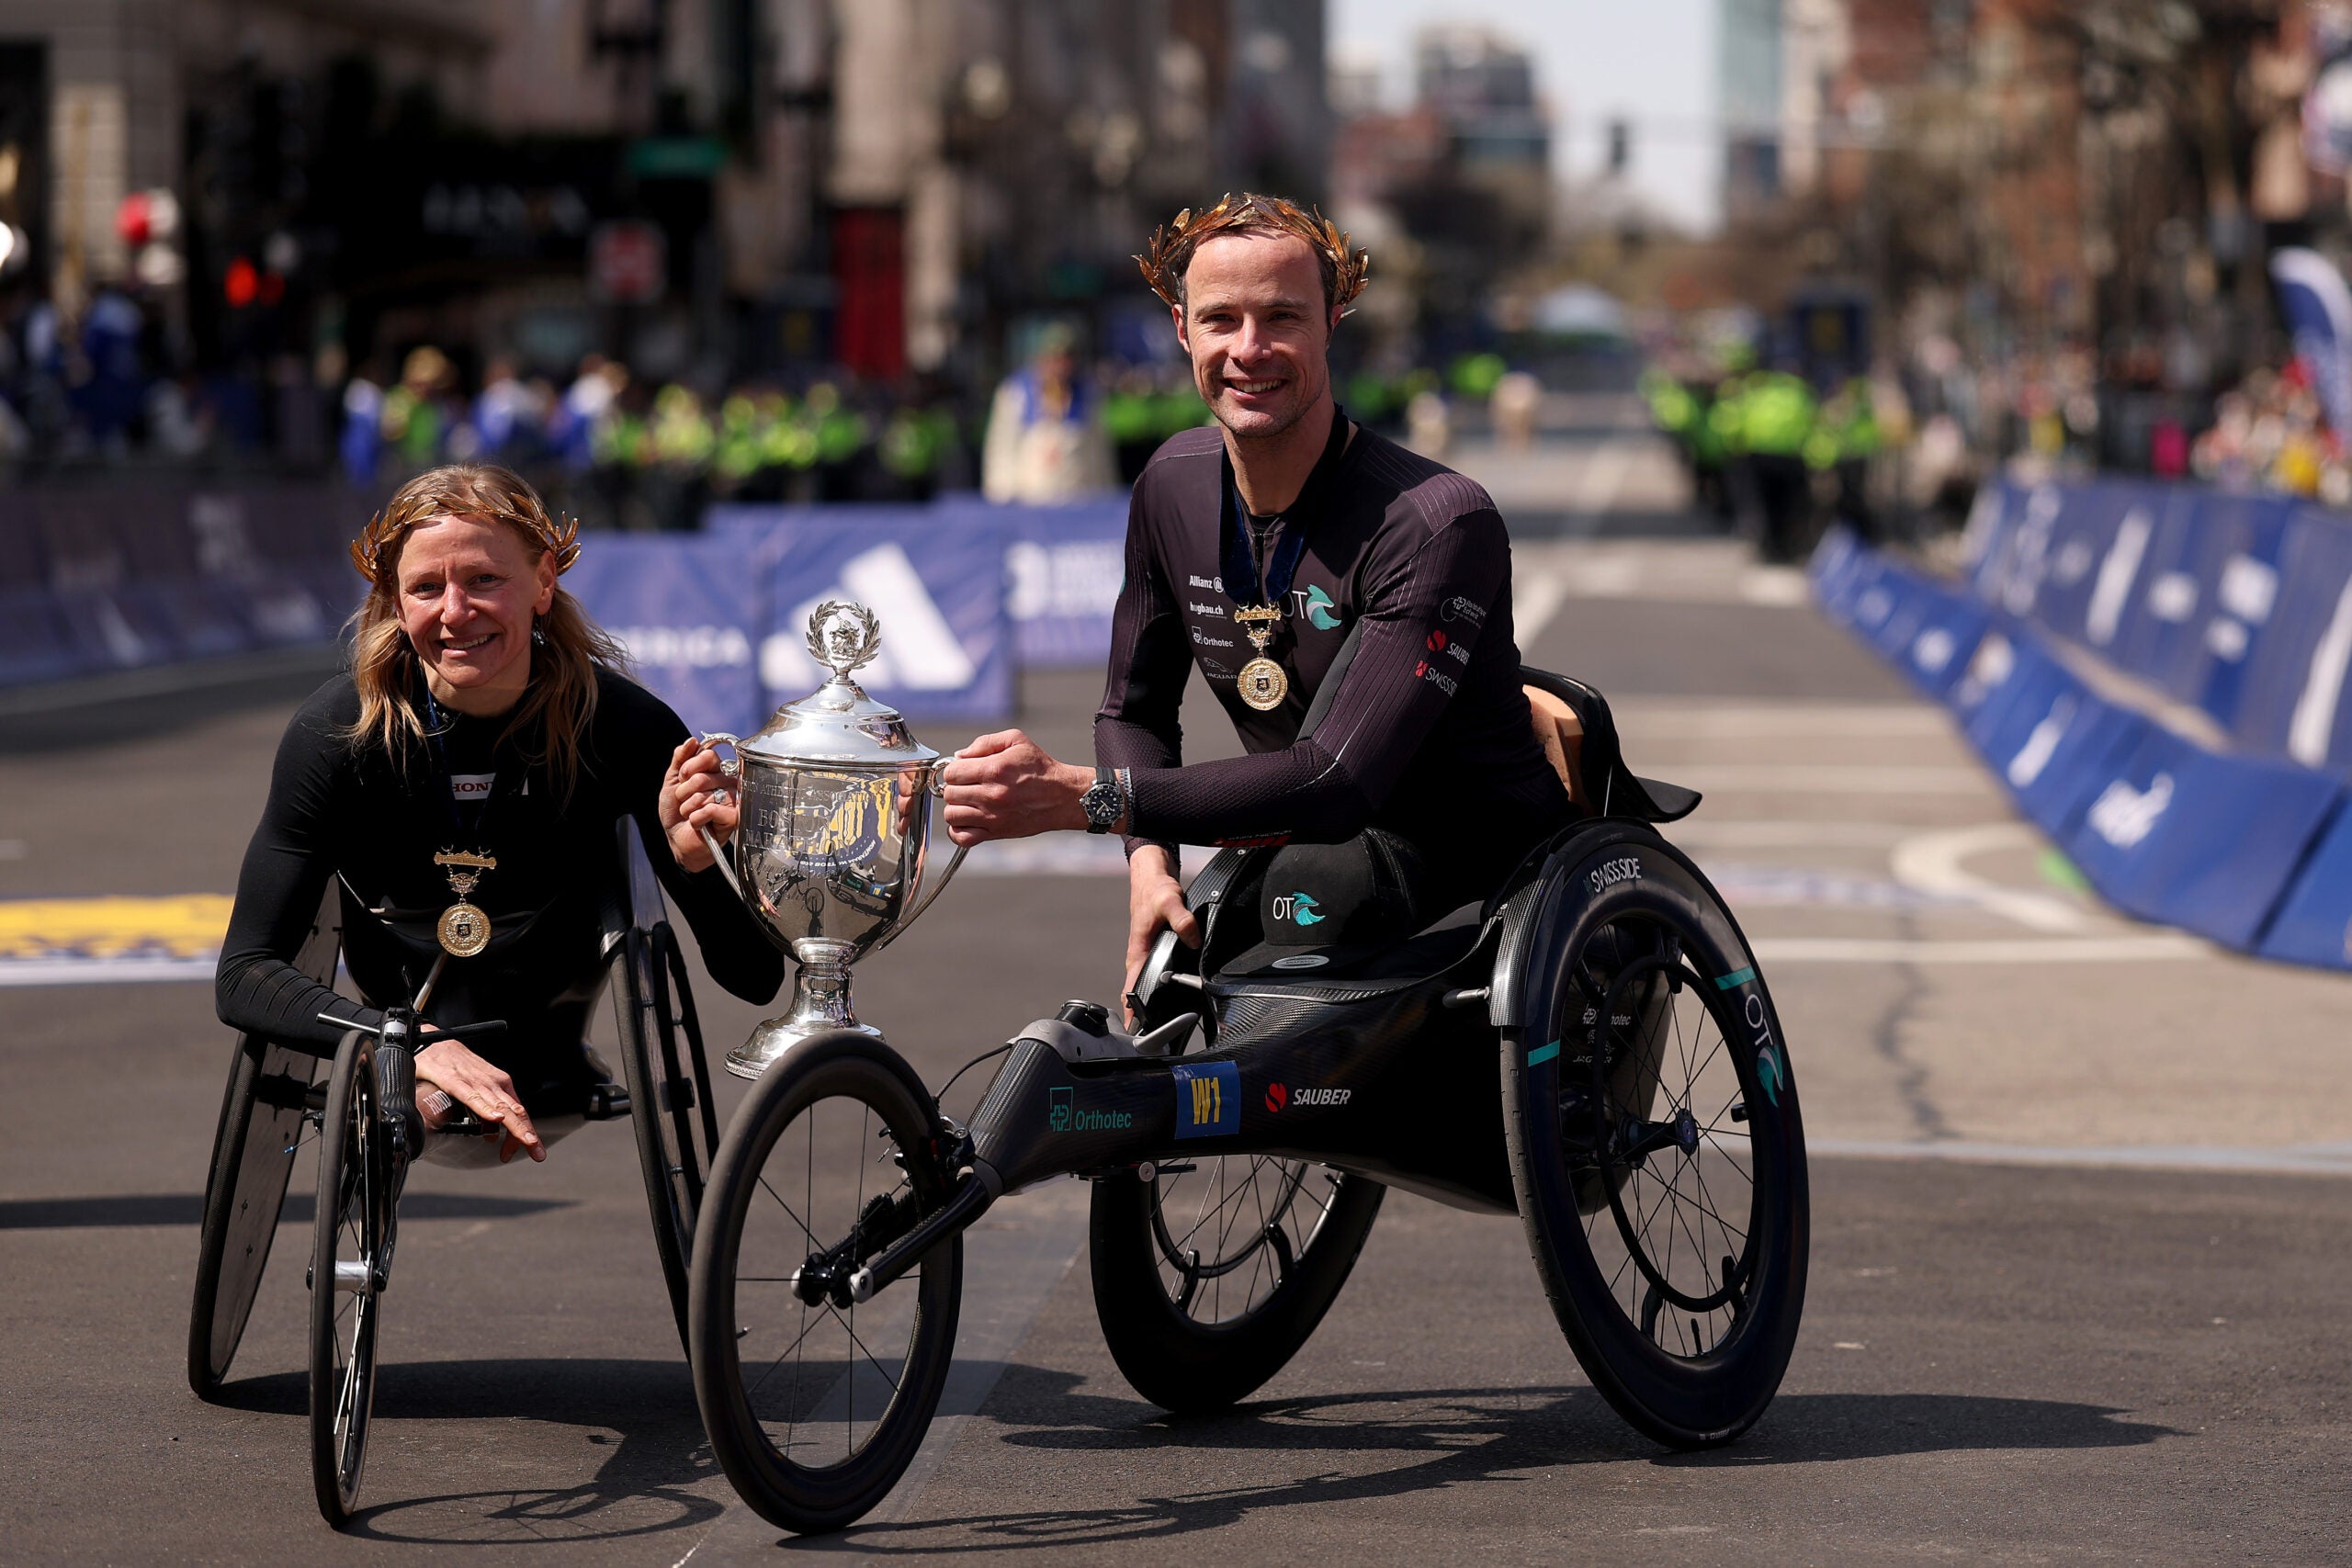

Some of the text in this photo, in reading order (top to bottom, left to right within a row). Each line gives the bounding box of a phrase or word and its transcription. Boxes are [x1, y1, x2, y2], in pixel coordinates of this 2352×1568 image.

[1189, 575, 1213, 589] Allianz
[1190, 602, 1224, 615] hugbau.ch
[1203, 637, 1234, 648] Orthotec
[1272, 897, 1295, 920] OT
[1746, 994, 1773, 1047] OT
[1190, 1077, 1222, 1125] W1
[1293, 1089, 1351, 1105] SAUBER
[1075, 1110, 1132, 1131] Orthotec
